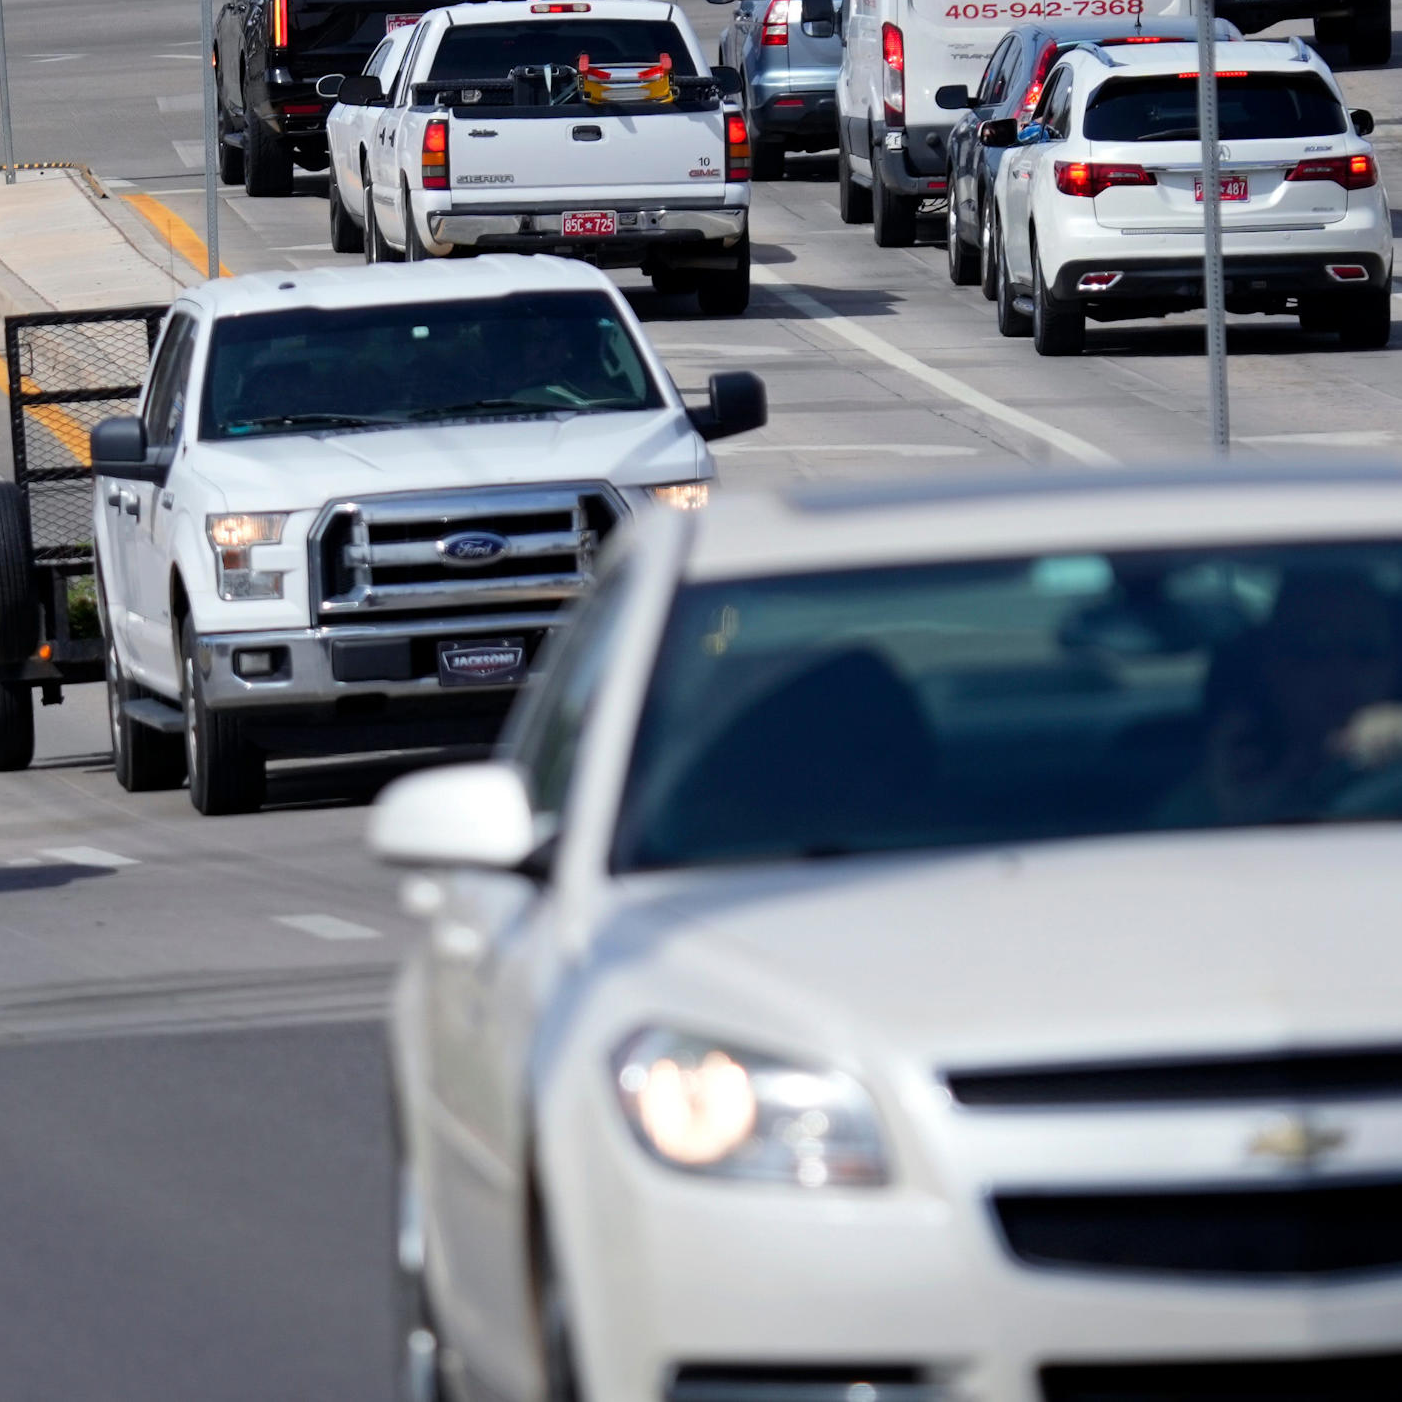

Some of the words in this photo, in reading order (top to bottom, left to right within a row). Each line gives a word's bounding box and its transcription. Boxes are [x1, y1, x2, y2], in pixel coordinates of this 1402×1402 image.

[698, 157, 710, 166] 10
[688, 168, 720, 177] GMC
[456, 174, 514, 184] SIERRA
[1226, 182, 1245, 196] 487
[565, 218, 584, 232] 85C
[594, 218, 614, 232] 725
[455, 540, 493, 559] Ford
